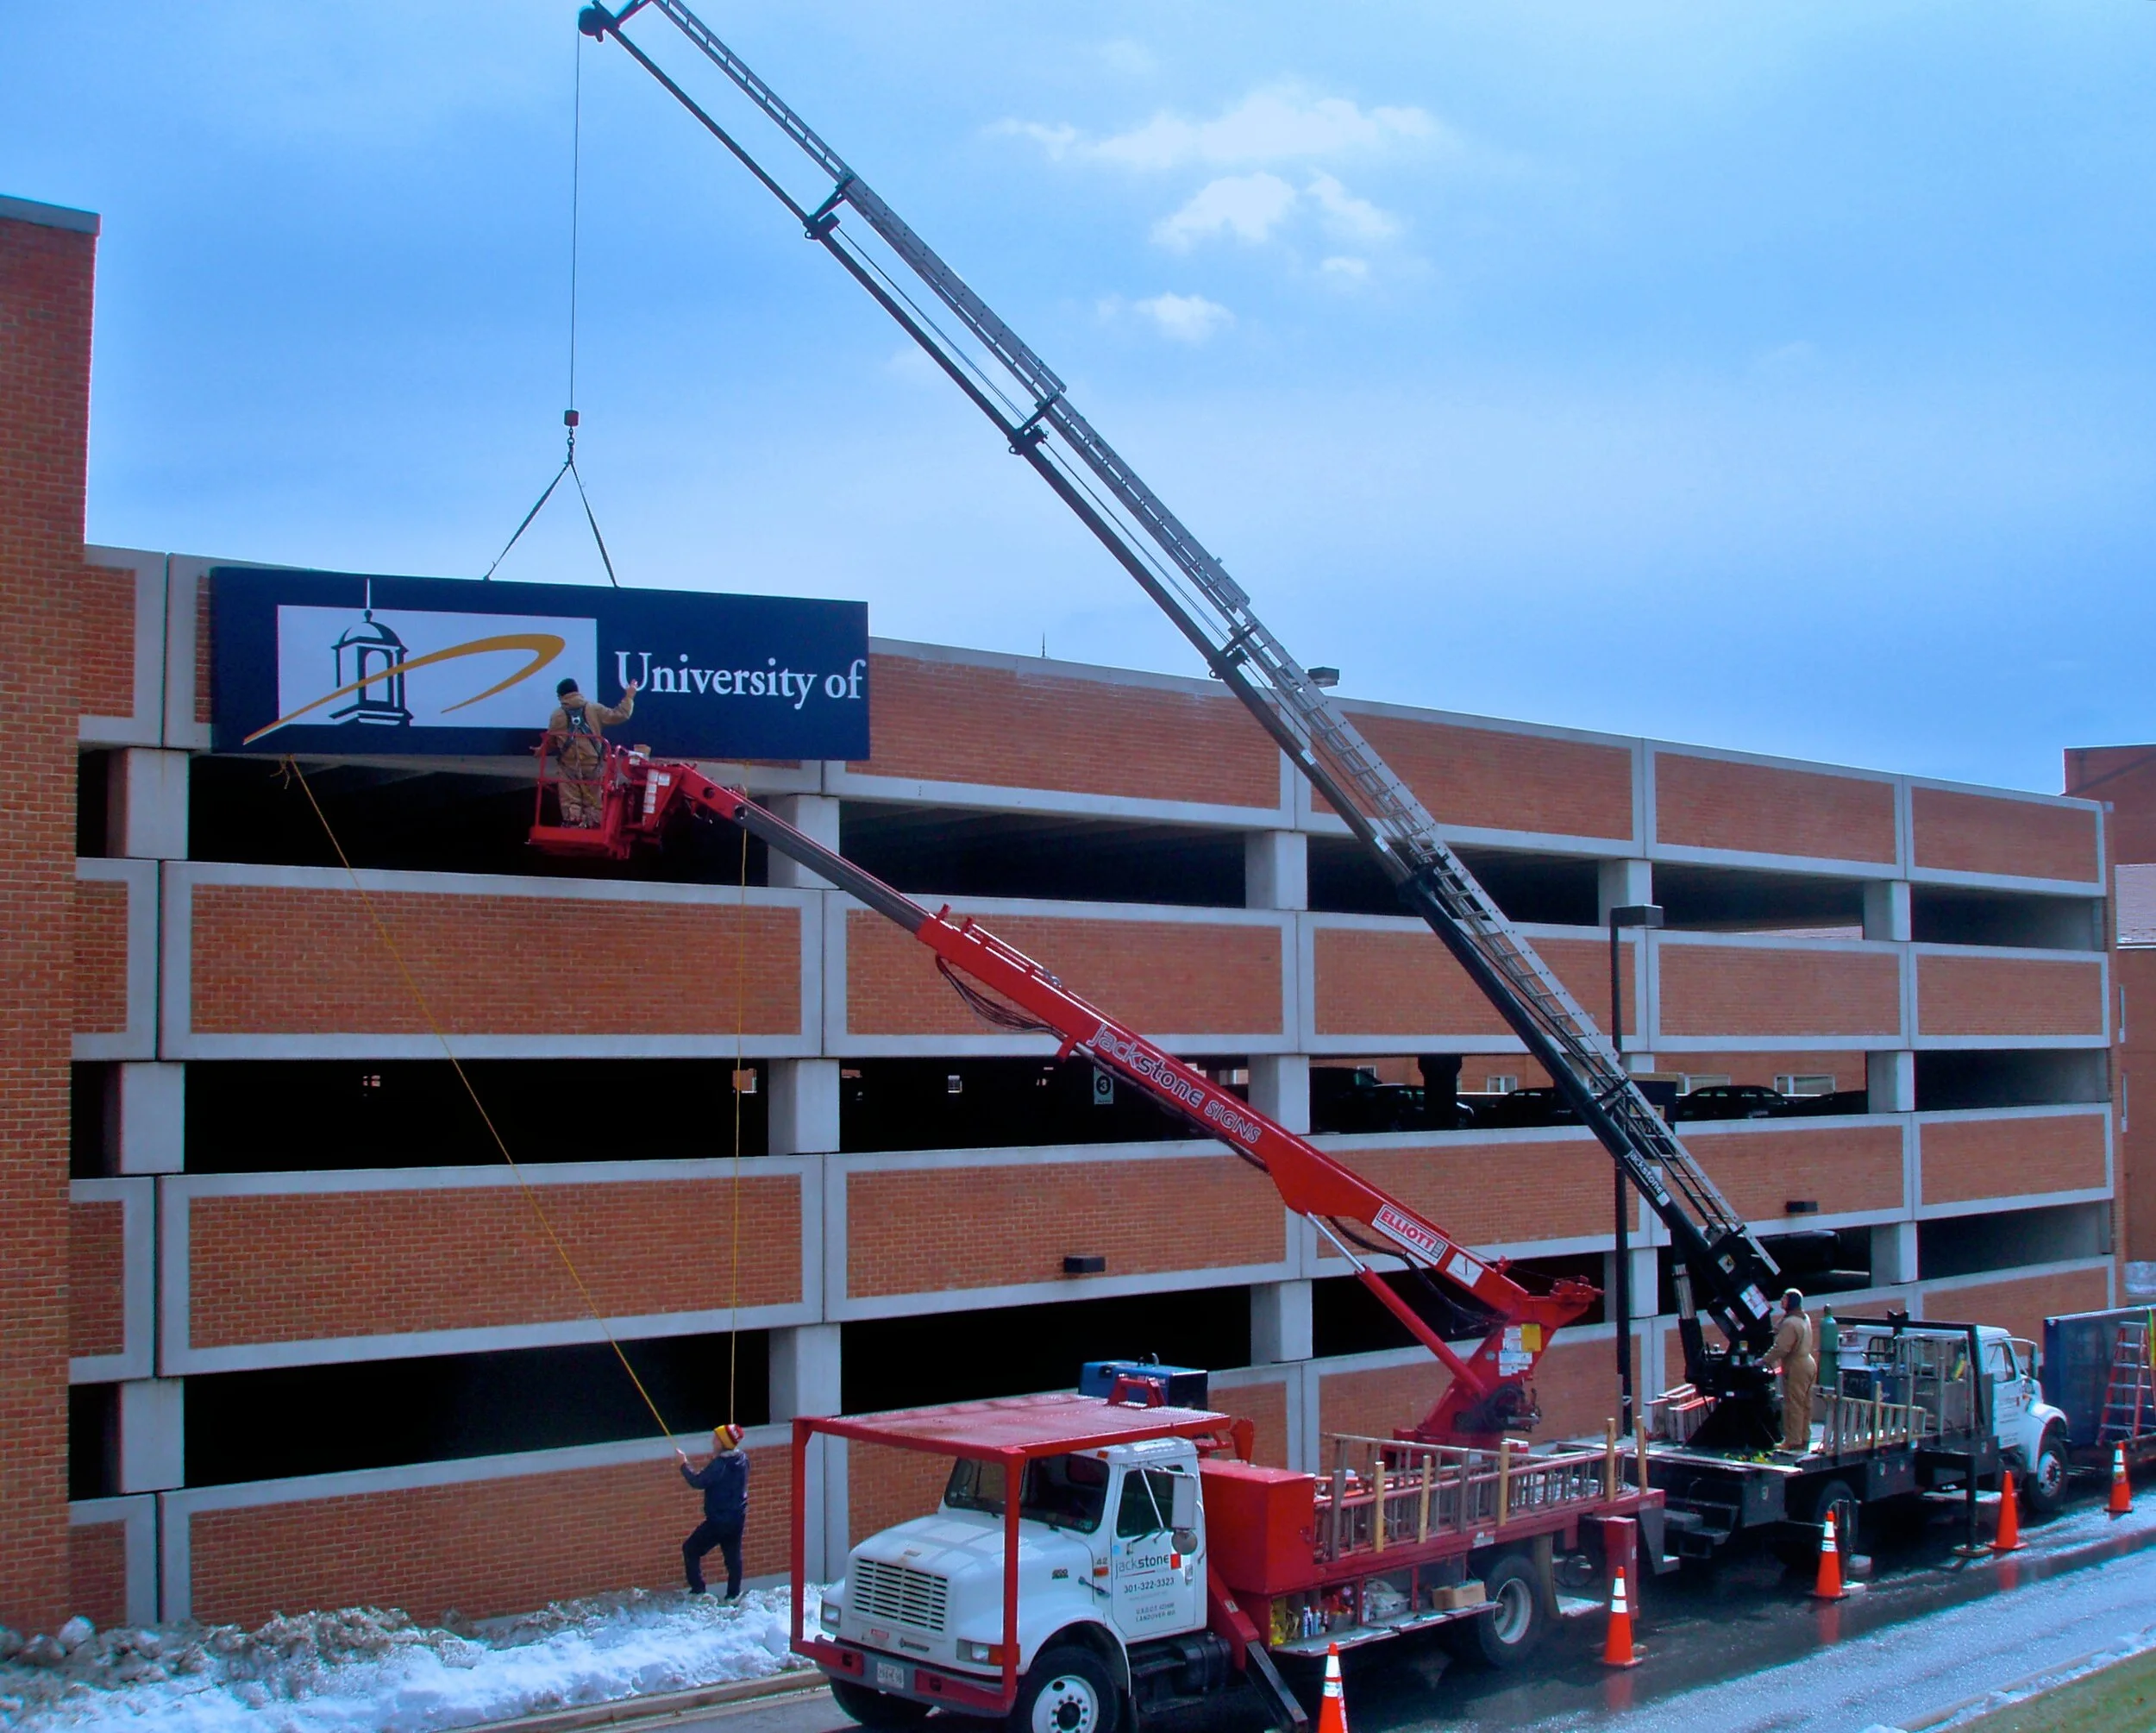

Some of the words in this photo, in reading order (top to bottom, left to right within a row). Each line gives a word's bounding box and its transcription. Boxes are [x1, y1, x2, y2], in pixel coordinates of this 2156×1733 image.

[615, 651, 818, 710] University
[824, 659, 866, 699] of
[1086, 1022, 1205, 1108] jackstone
[1204, 1100, 1262, 1144] SIGNS
[1100, 1079, 1108, 1092] 3
[1624, 1149, 1663, 1194] jackstone
[1381, 1209, 1436, 1250] ELLIOTT
[1115, 1554, 1169, 1579] jackstone
[1124, 1577, 1175, 1594] 301-322-3323
